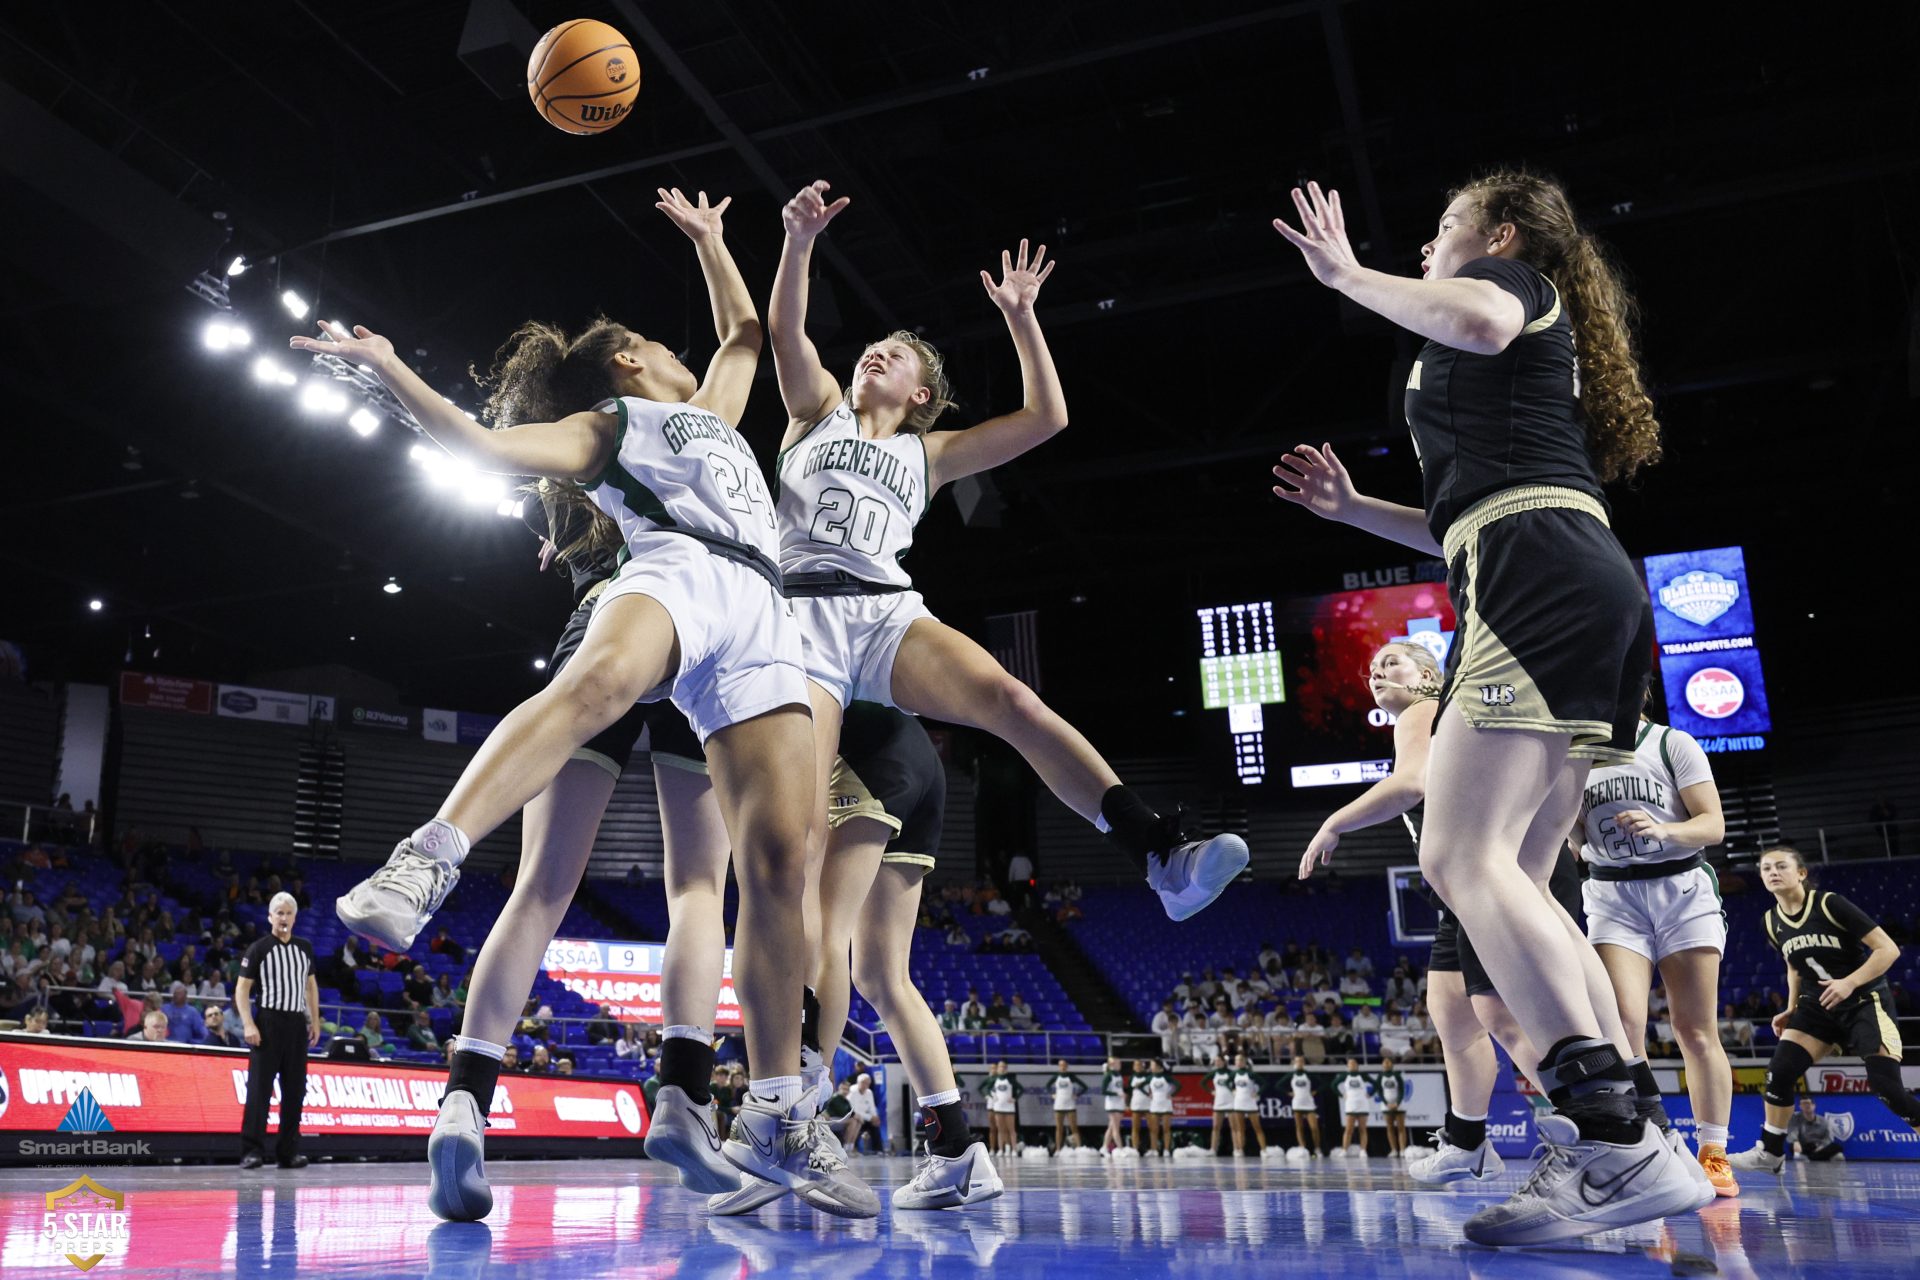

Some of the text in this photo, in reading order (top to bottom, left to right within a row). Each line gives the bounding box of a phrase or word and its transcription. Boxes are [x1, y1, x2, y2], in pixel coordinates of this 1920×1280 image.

[802, 438, 916, 513] GREENEVILLE
[809, 486, 890, 557] 20
[1343, 566, 1410, 590] BLUE
[1691, 685, 1739, 699] TSSAA
[1332, 768, 1340, 780] 9
[1583, 776, 1665, 818] REENEVILLE
[1782, 934, 1841, 957] PPERMAN
[623, 950, 634, 968] 9
[18, 1068, 142, 1107] UPPERMAN
[323, 1075, 413, 1109] BASKETBALL
[1485, 1120, 1527, 1136] cend
[1859, 1129, 1876, 1142] of
